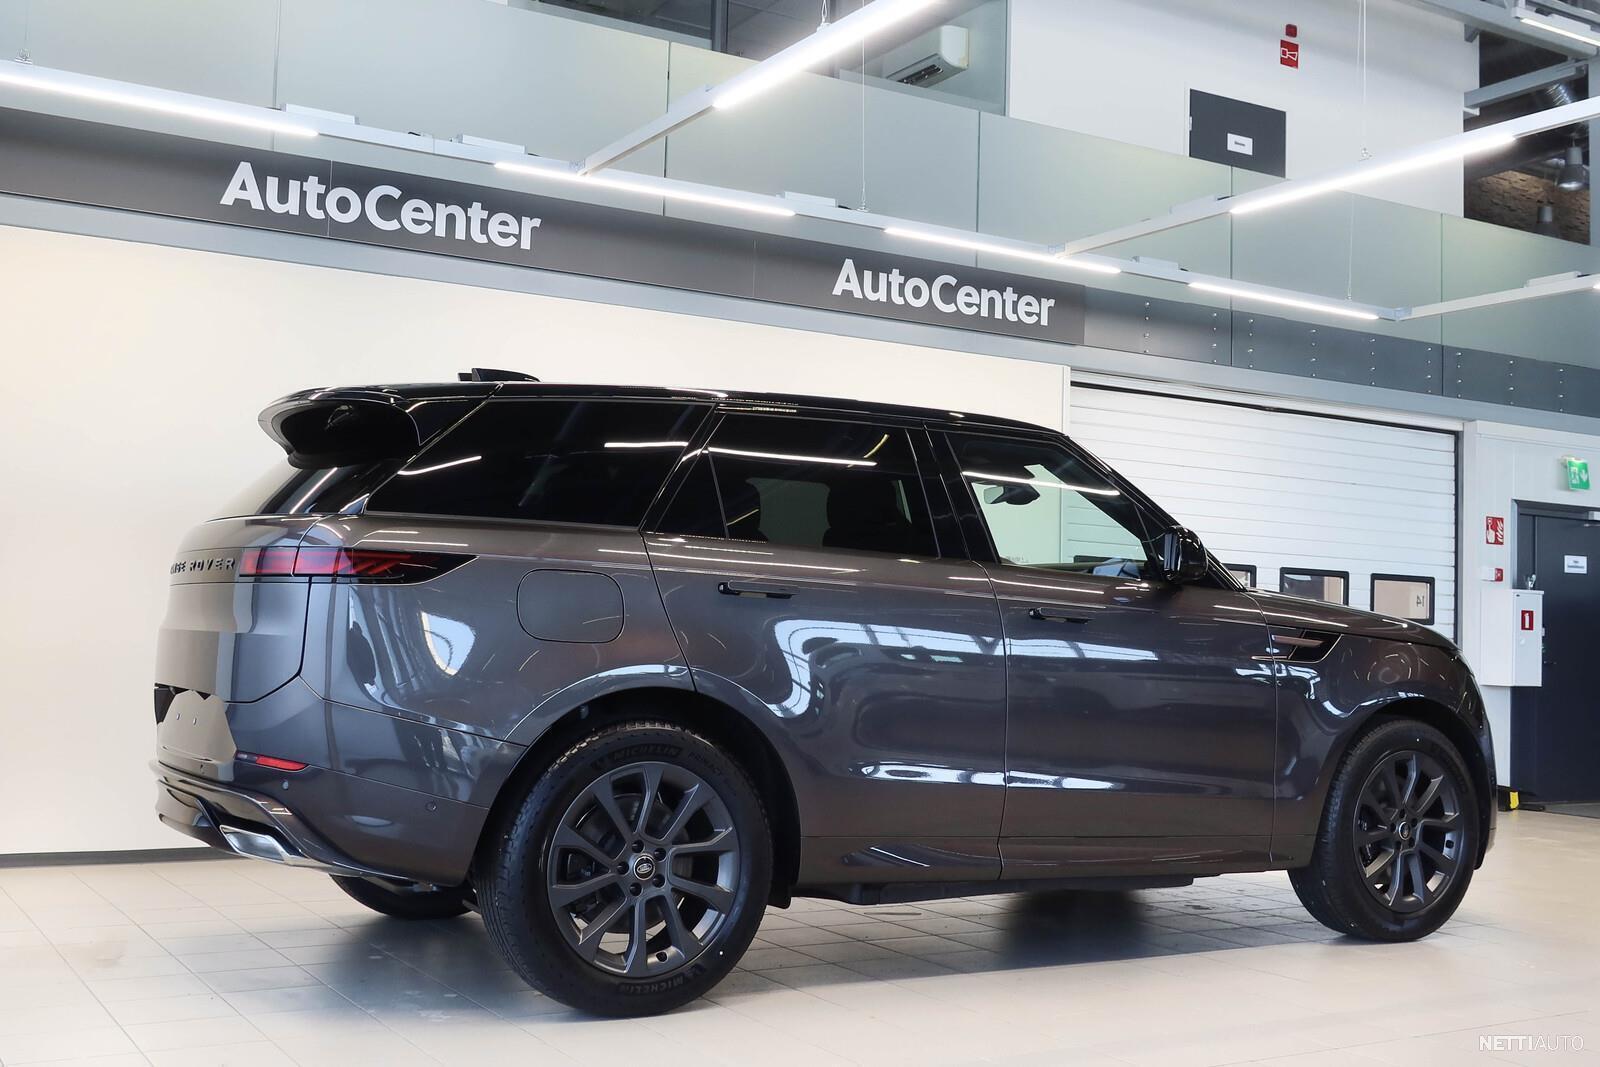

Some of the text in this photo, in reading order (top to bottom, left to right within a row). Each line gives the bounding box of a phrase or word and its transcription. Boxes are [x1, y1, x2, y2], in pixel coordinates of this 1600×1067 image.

[220, 161, 542, 250] AutoCenter
[832, 258, 1055, 326] AutoCenter
[190, 558, 236, 571] ROVER
